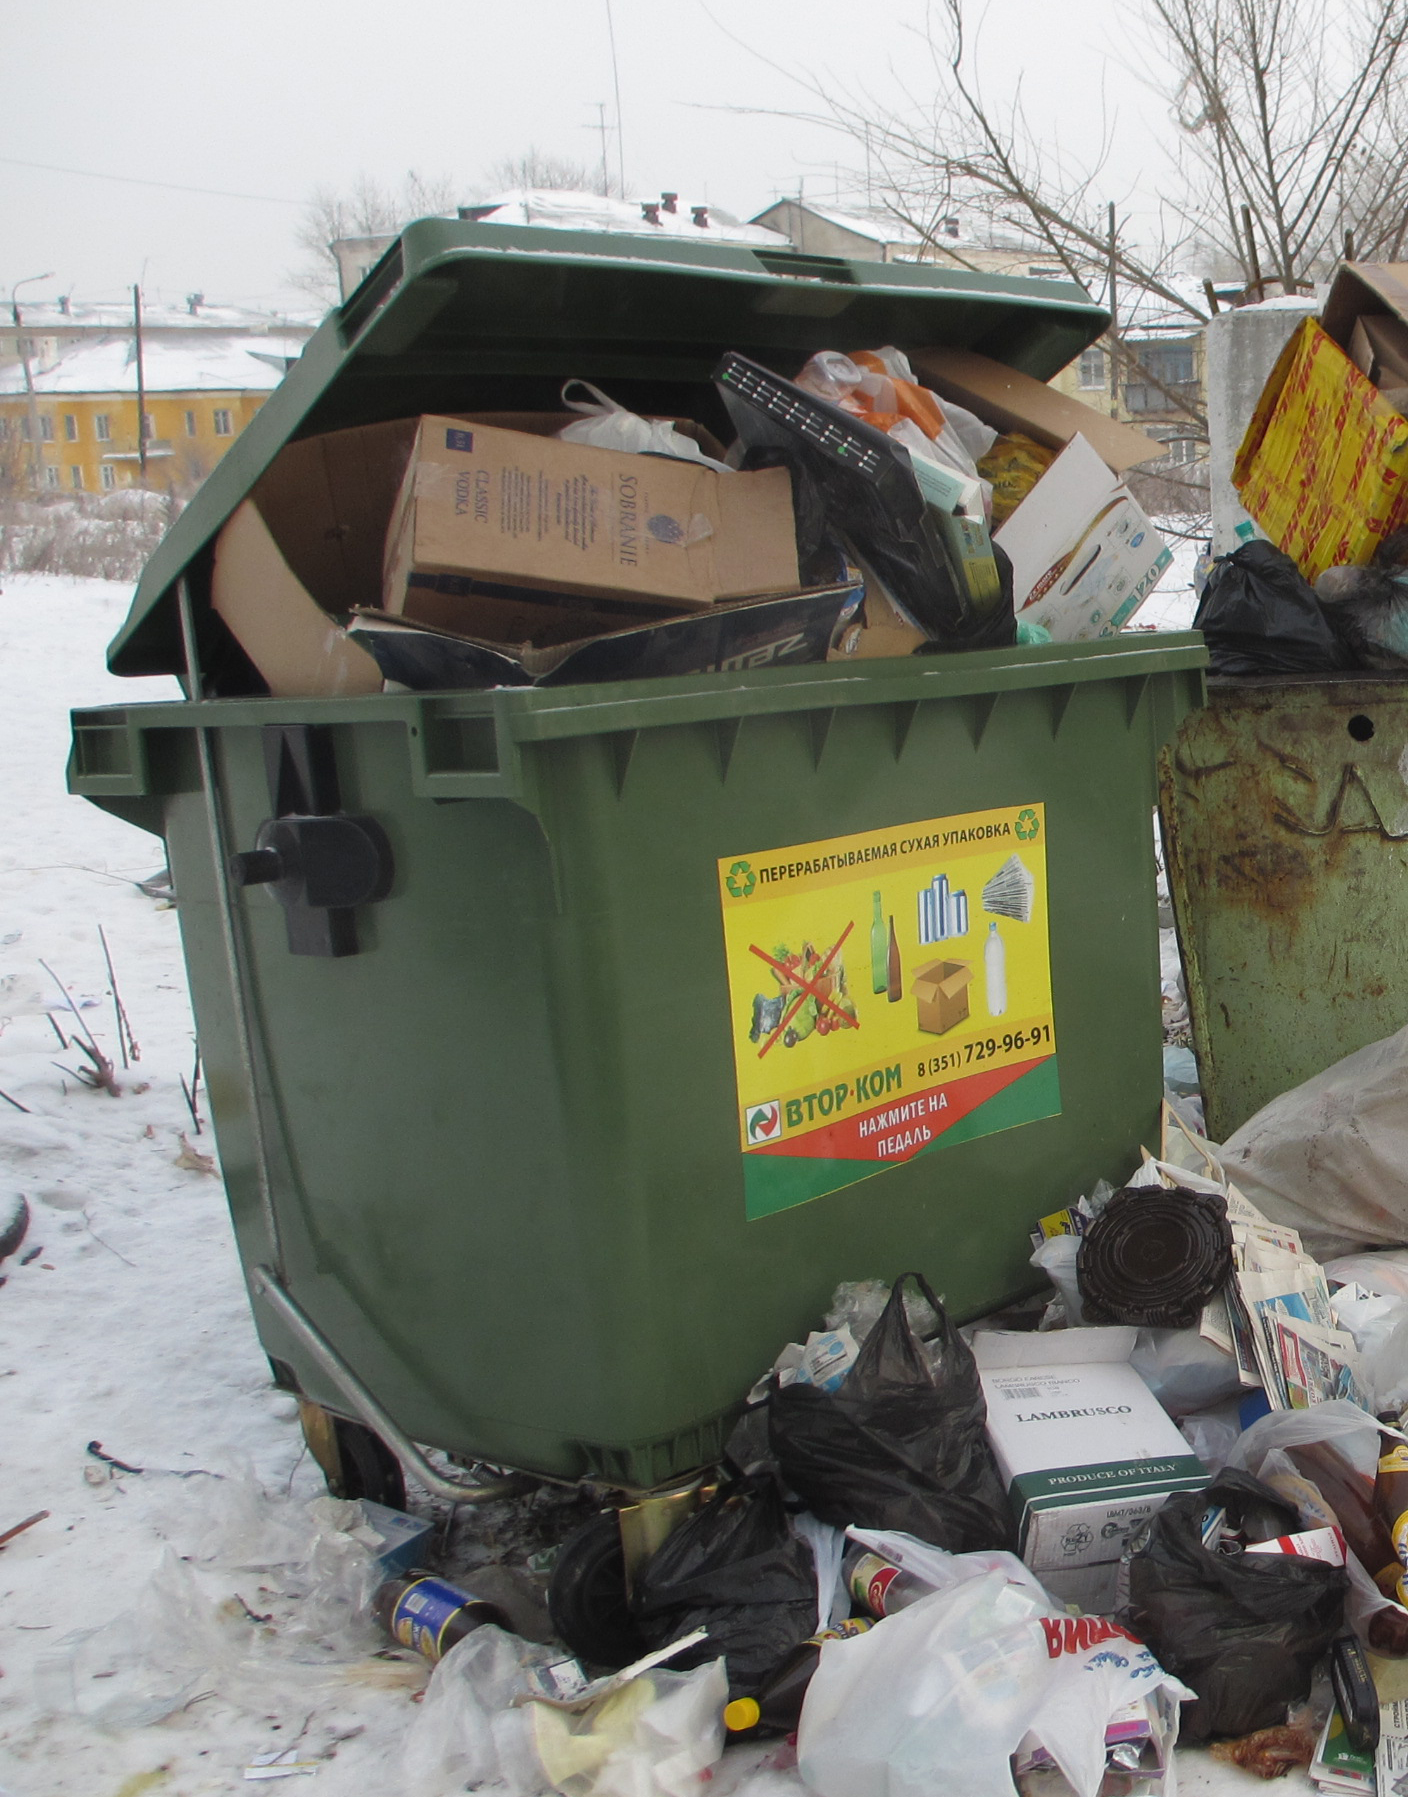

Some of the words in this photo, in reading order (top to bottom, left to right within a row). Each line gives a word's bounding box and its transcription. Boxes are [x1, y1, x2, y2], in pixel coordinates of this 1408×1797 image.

[455, 470, 470, 518] VODKA
[473, 470, 489, 525] CLASSIC
[618, 474, 639, 568] SOBRANIE
[1132, 564, 1160, 602] 120
[759, 843, 898, 884] ПЕРЕРАБАТЫВАЕМАЯ
[899, 834, 941, 855] СУХАЯ
[942, 822, 1012, 847] УПАКОВКА
[917, 1062, 925, 1078] 8
[928, 1051, 962, 1076] (351)
[963, 1024, 1052, 1064] 729-96-91
[858, 1101, 926, 1139] НАЖМИТЕ
[926, 1092, 948, 1112] НА
[877, 1124, 933, 1158] ПЕДАЛЬ
[1015, 1404, 1133, 1423] LAMBRUSCO
[1048, 1469, 1116, 1486] PRODUCE
[1117, 1467, 1138, 1479] OF
[1138, 1462, 1178, 1476] ITALY
